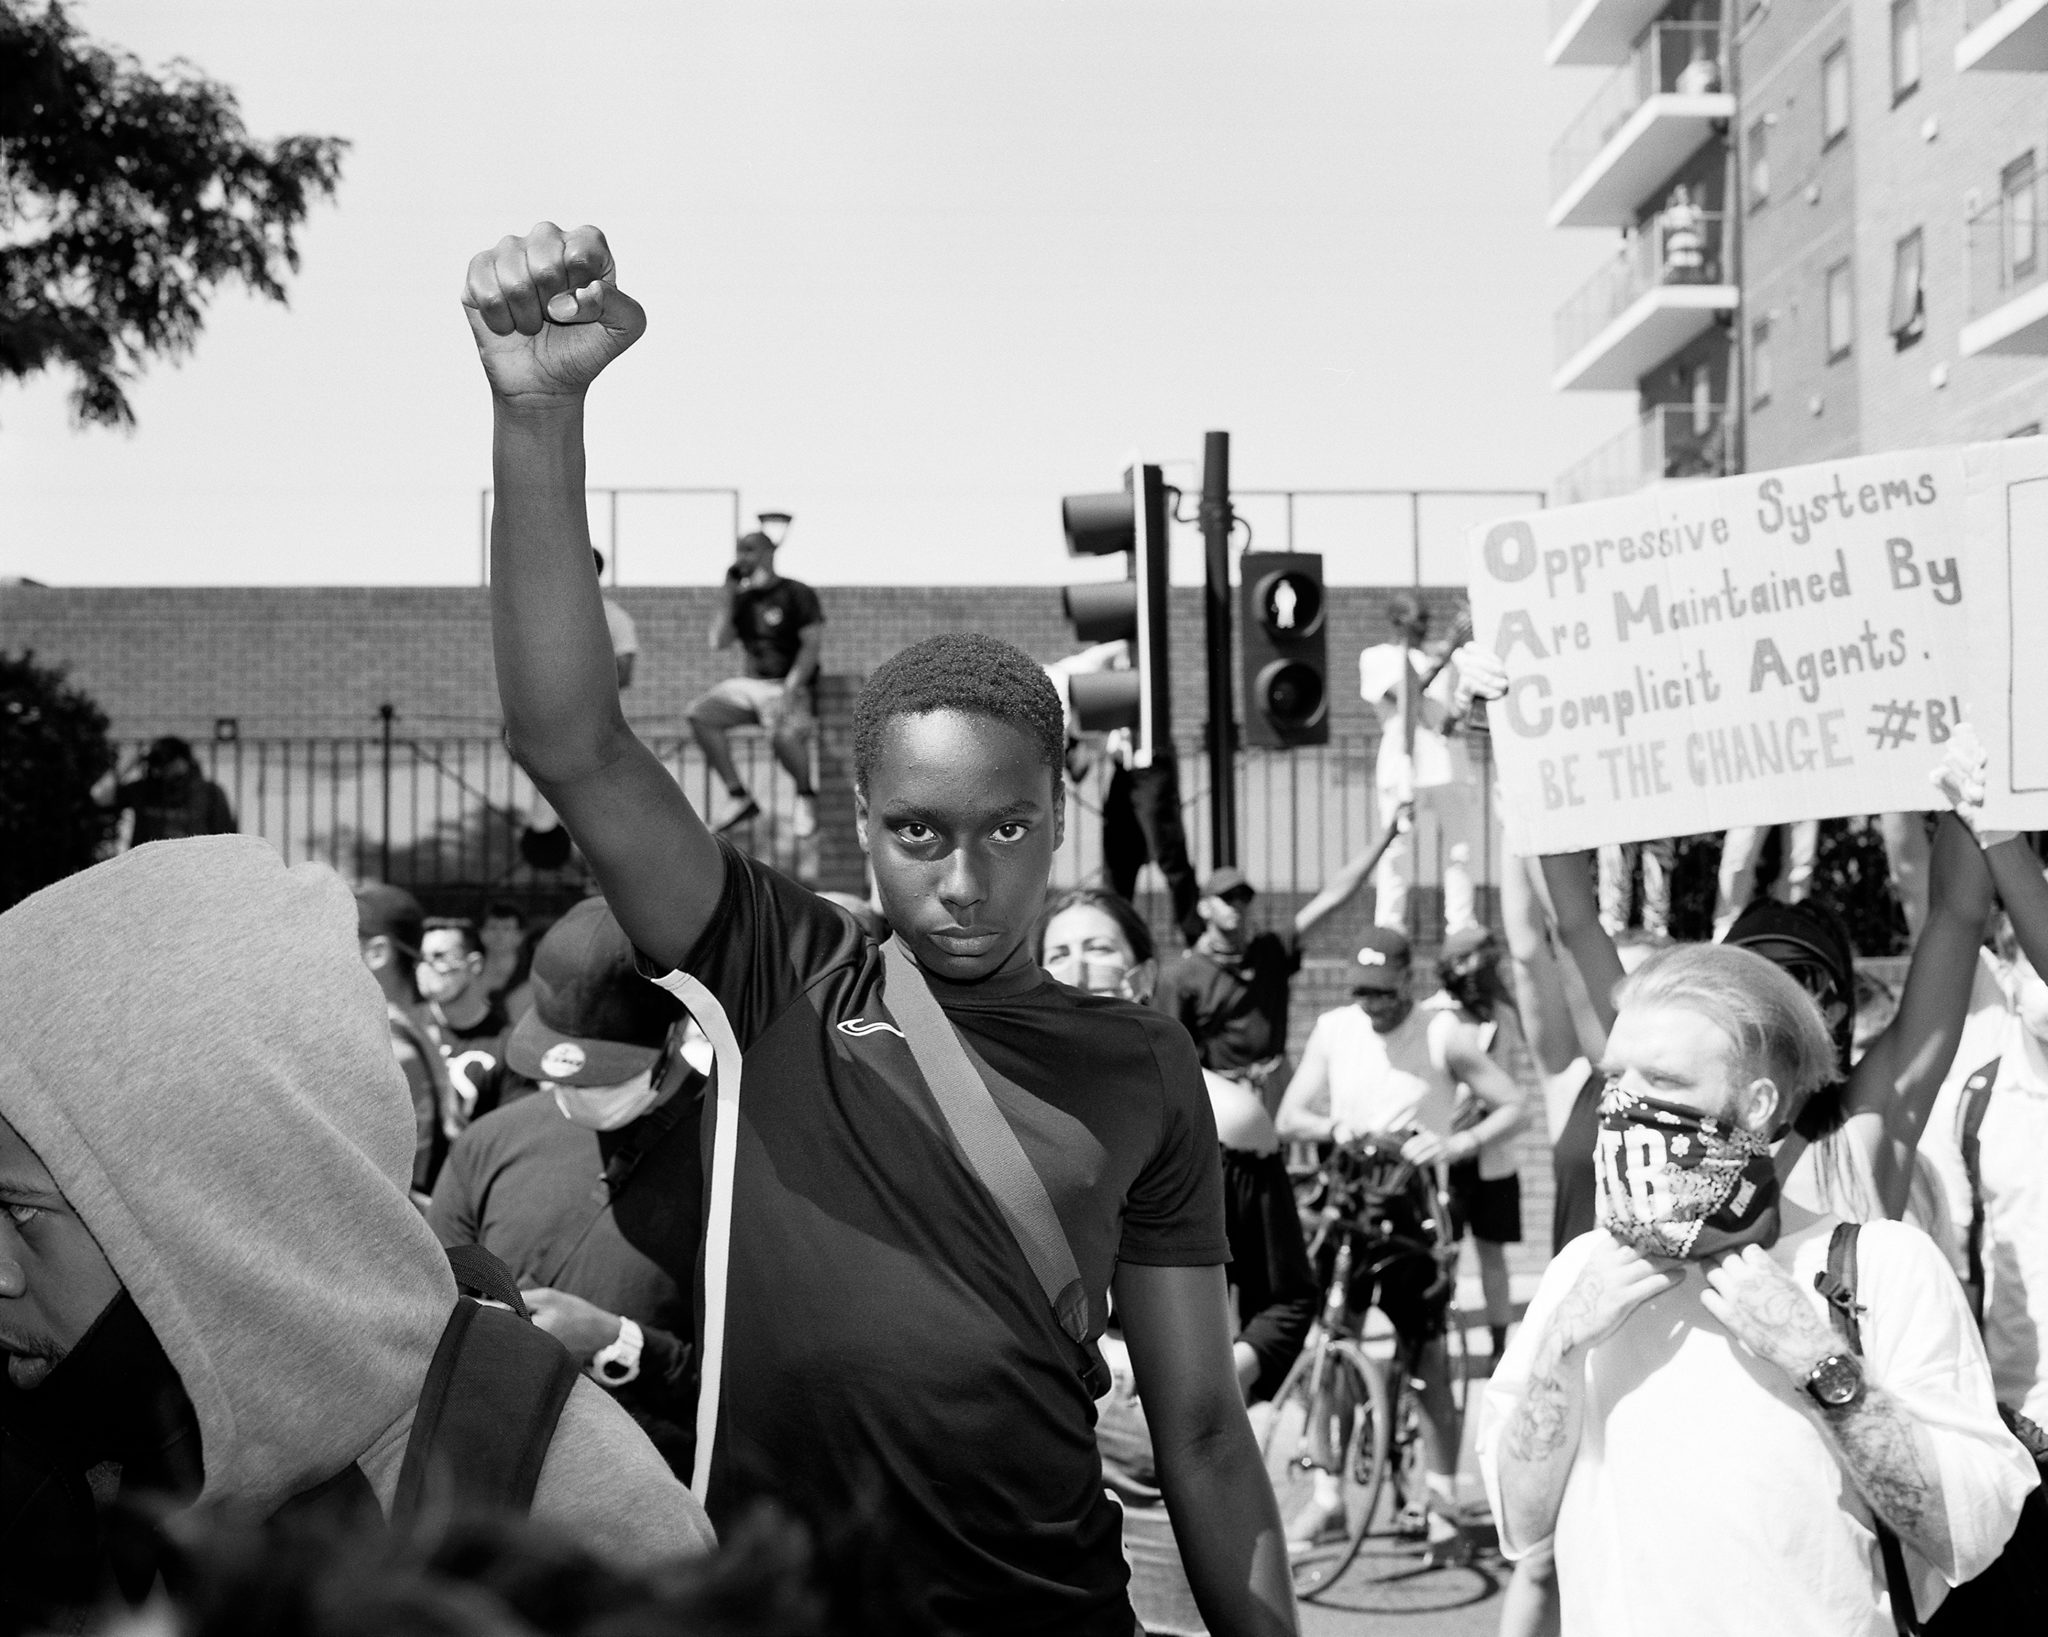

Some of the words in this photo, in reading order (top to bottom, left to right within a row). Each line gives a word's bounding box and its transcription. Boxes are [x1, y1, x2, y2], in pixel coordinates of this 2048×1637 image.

[1483, 514, 1730, 598] Oppressive
[1757, 472, 1938, 545] Systems
[1494, 607, 1592, 661] Are
[1612, 547, 1853, 643] Maintained
[1885, 536, 1965, 607] By
[1504, 649, 1721, 740] Complicit
[1537, 752, 1587, 812] BE
[1597, 739, 1673, 803] THE
[1685, 708, 1855, 789] CHANGE
